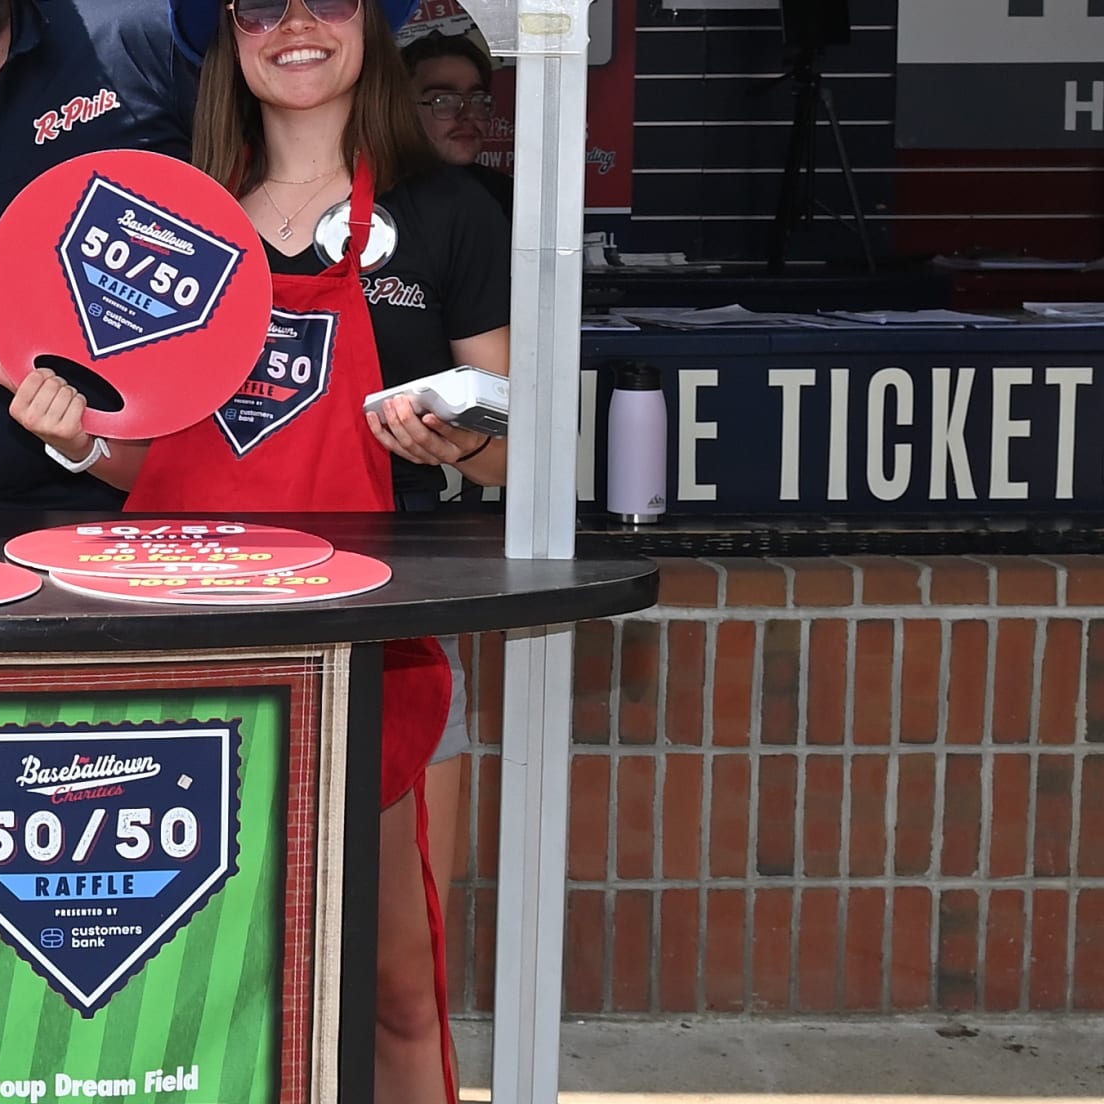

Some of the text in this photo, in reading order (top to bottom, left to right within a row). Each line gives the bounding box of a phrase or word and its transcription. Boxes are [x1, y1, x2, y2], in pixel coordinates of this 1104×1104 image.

[435, 4, 446, 17] 3
[33, 88, 119, 145] R-Phils
[80, 225, 200, 307] 50/50
[97, 274, 153, 311] RAFFLE
[102, 316, 123, 330] bank
[105, 310, 144, 334] customers
[768, 367, 1093, 502] TICKET
[76, 524, 246, 536] 50/50
[78, 552, 274, 563] 100 for $20
[127, 576, 330, 587] 100 for $20
[16, 752, 162, 788] Baseballtown
[34, 873, 136, 898] RAFFLE
[54, 907, 119, 918] PRESENTED BY
[71, 923, 143, 938] customers
[71, 935, 106, 949] bank
[55, 1071, 136, 1097] Dream
[143, 1065, 199, 1094] Field
